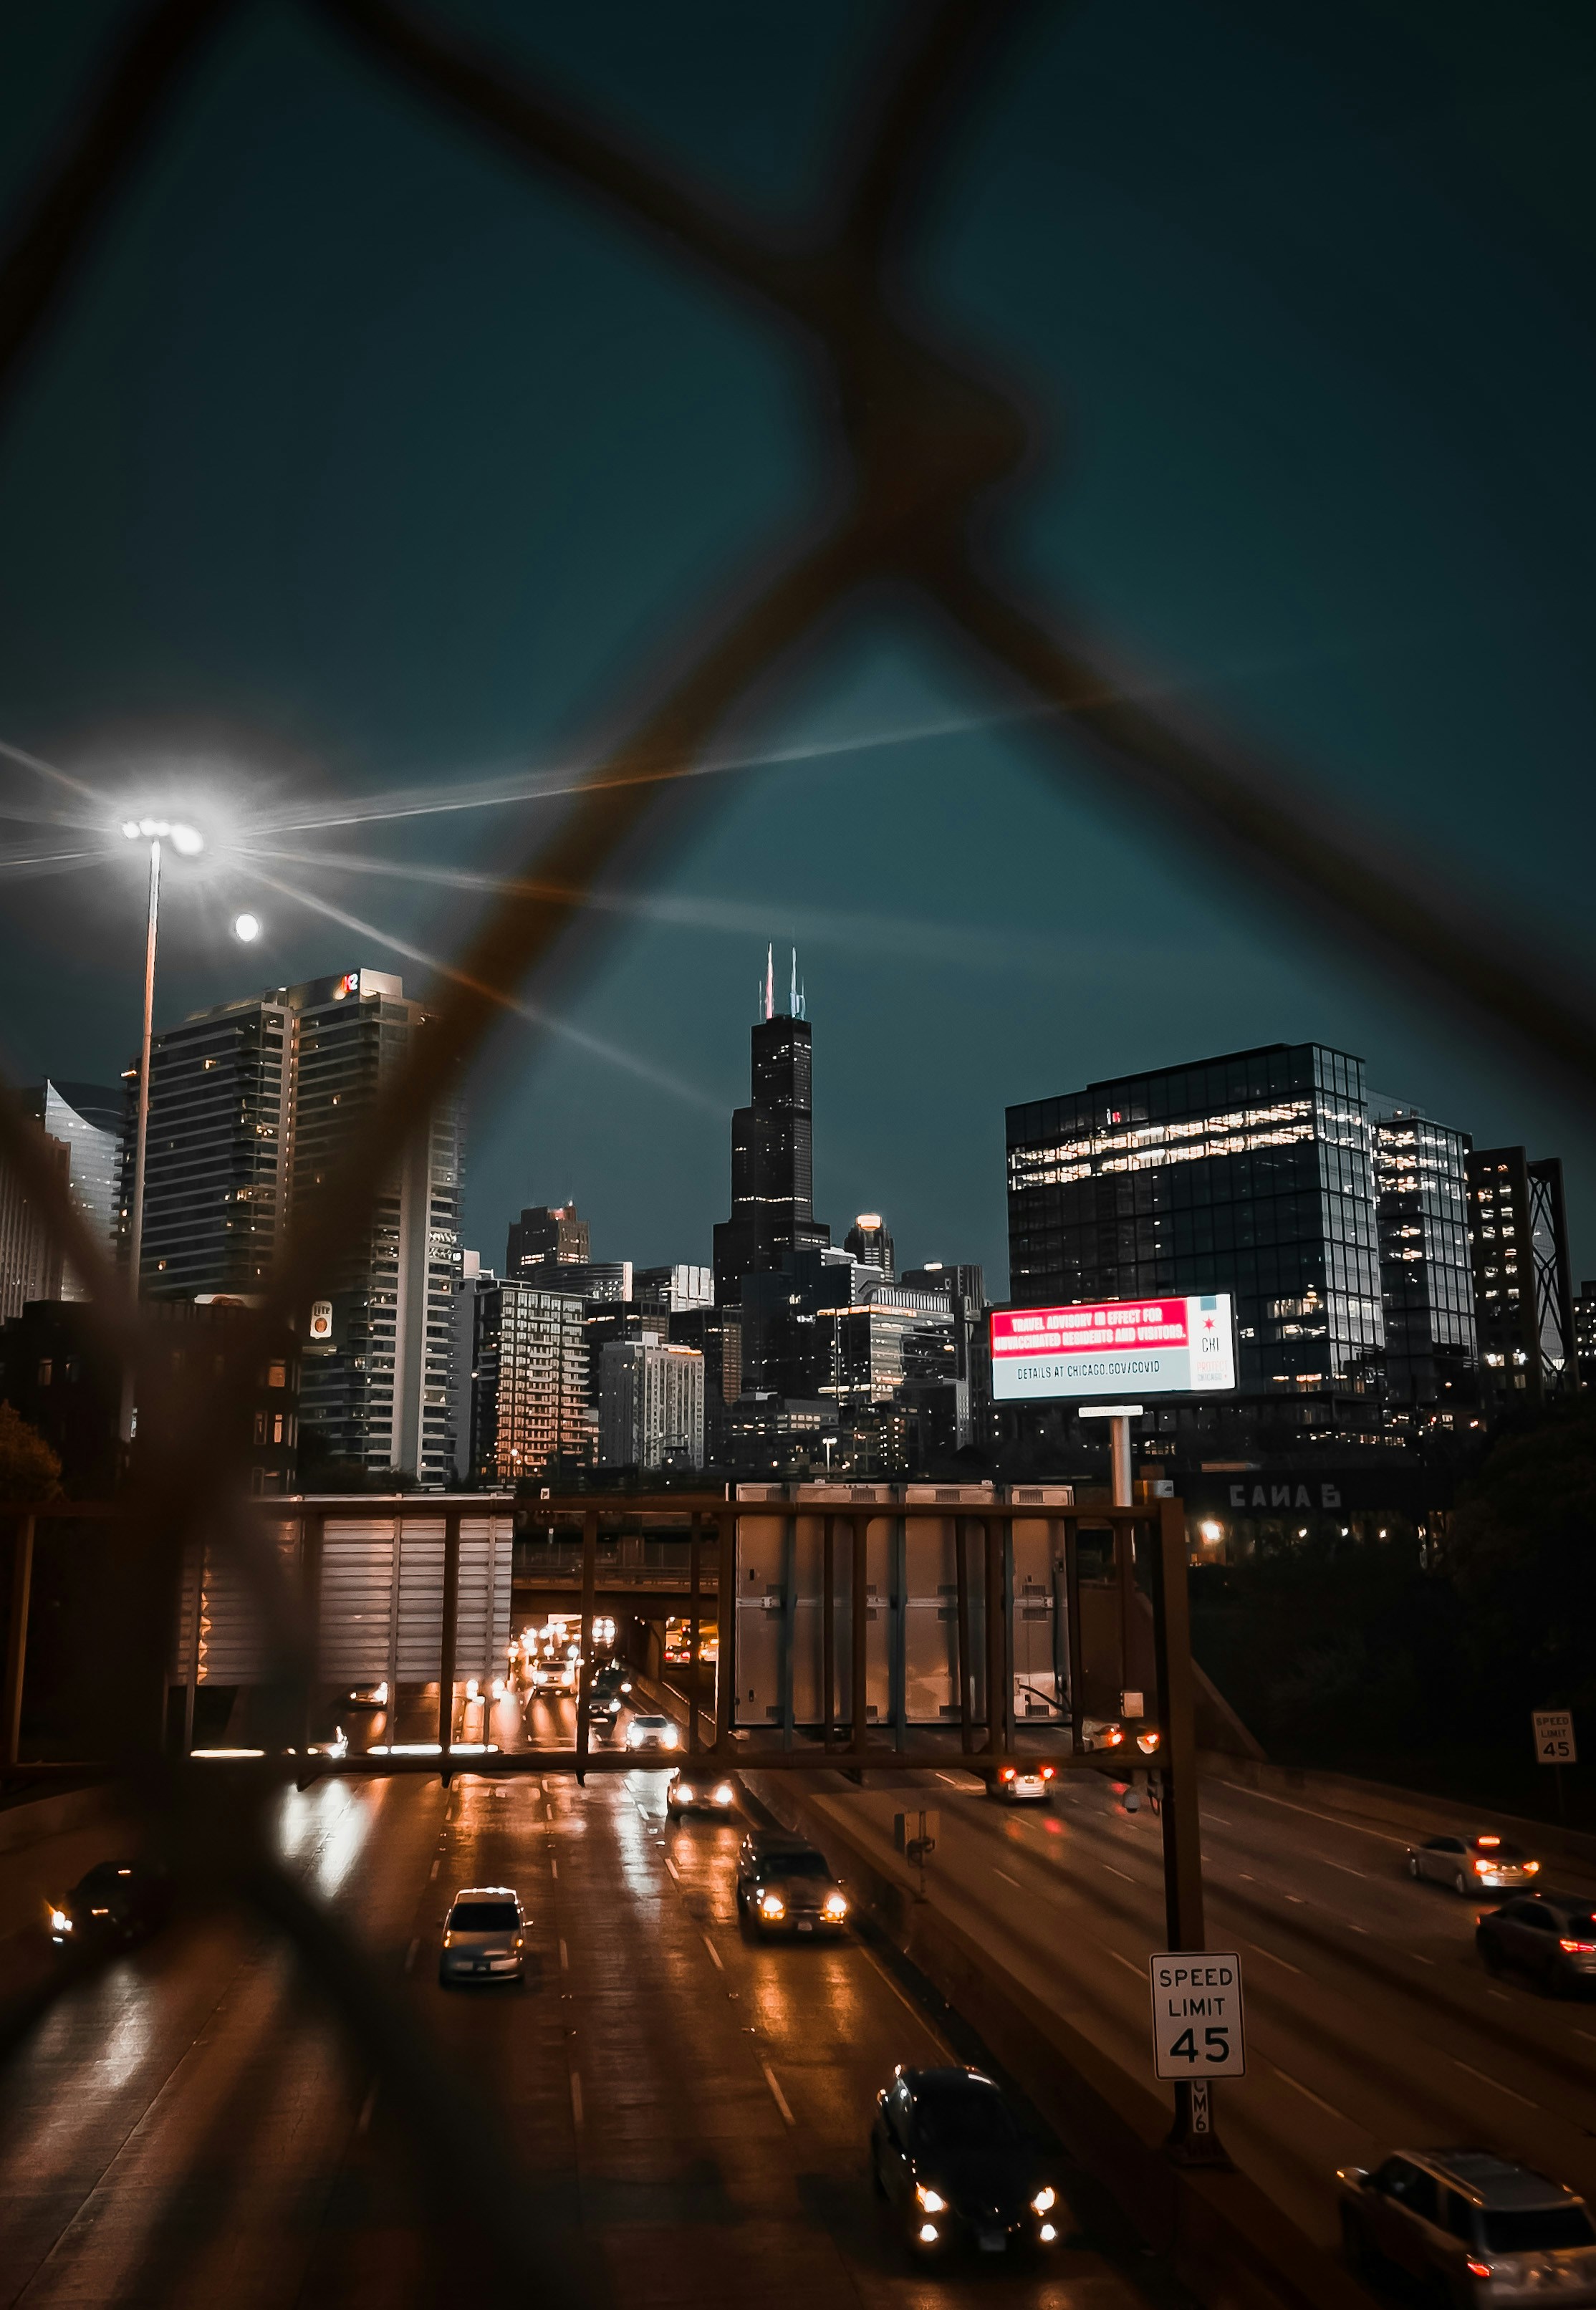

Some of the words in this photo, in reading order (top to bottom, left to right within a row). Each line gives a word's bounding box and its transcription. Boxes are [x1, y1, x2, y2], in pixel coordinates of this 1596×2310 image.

[1012, 1317, 1045, 1333] TRAVEL
[1047, 1312, 1092, 1330] ADVISORY
[1095, 1312, 1106, 1326] IN
[1107, 1309, 1141, 1325] EFFECT
[1143, 1307, 1162, 1323] FOR
[994, 1332, 1061, 1351] UNVACCINATED
[1062, 1329, 1114, 1346] RESIDENTS
[1115, 1327, 1136, 1343] AND
[1137, 1324, 1186, 1341] VISITORS.
[1201, 1337, 1220, 1353] CHI
[1018, 1367, 1051, 1380] DETAILS
[1054, 1366, 1064, 1377] AT
[1067, 1359, 1160, 1377] CHICAGO.GOV/COVID
[1197, 1359, 1228, 1372] PROTECT
[1536, 1717, 1569, 1726] SPEED
[1541, 1729, 1567, 1738] LIMIT
[1542, 1741, 1570, 1757] 45
[1159, 1968, 1234, 1988] SPEED
[1168, 1997, 1226, 2017] LIMIT
[1169, 2026, 1230, 2064] 45
